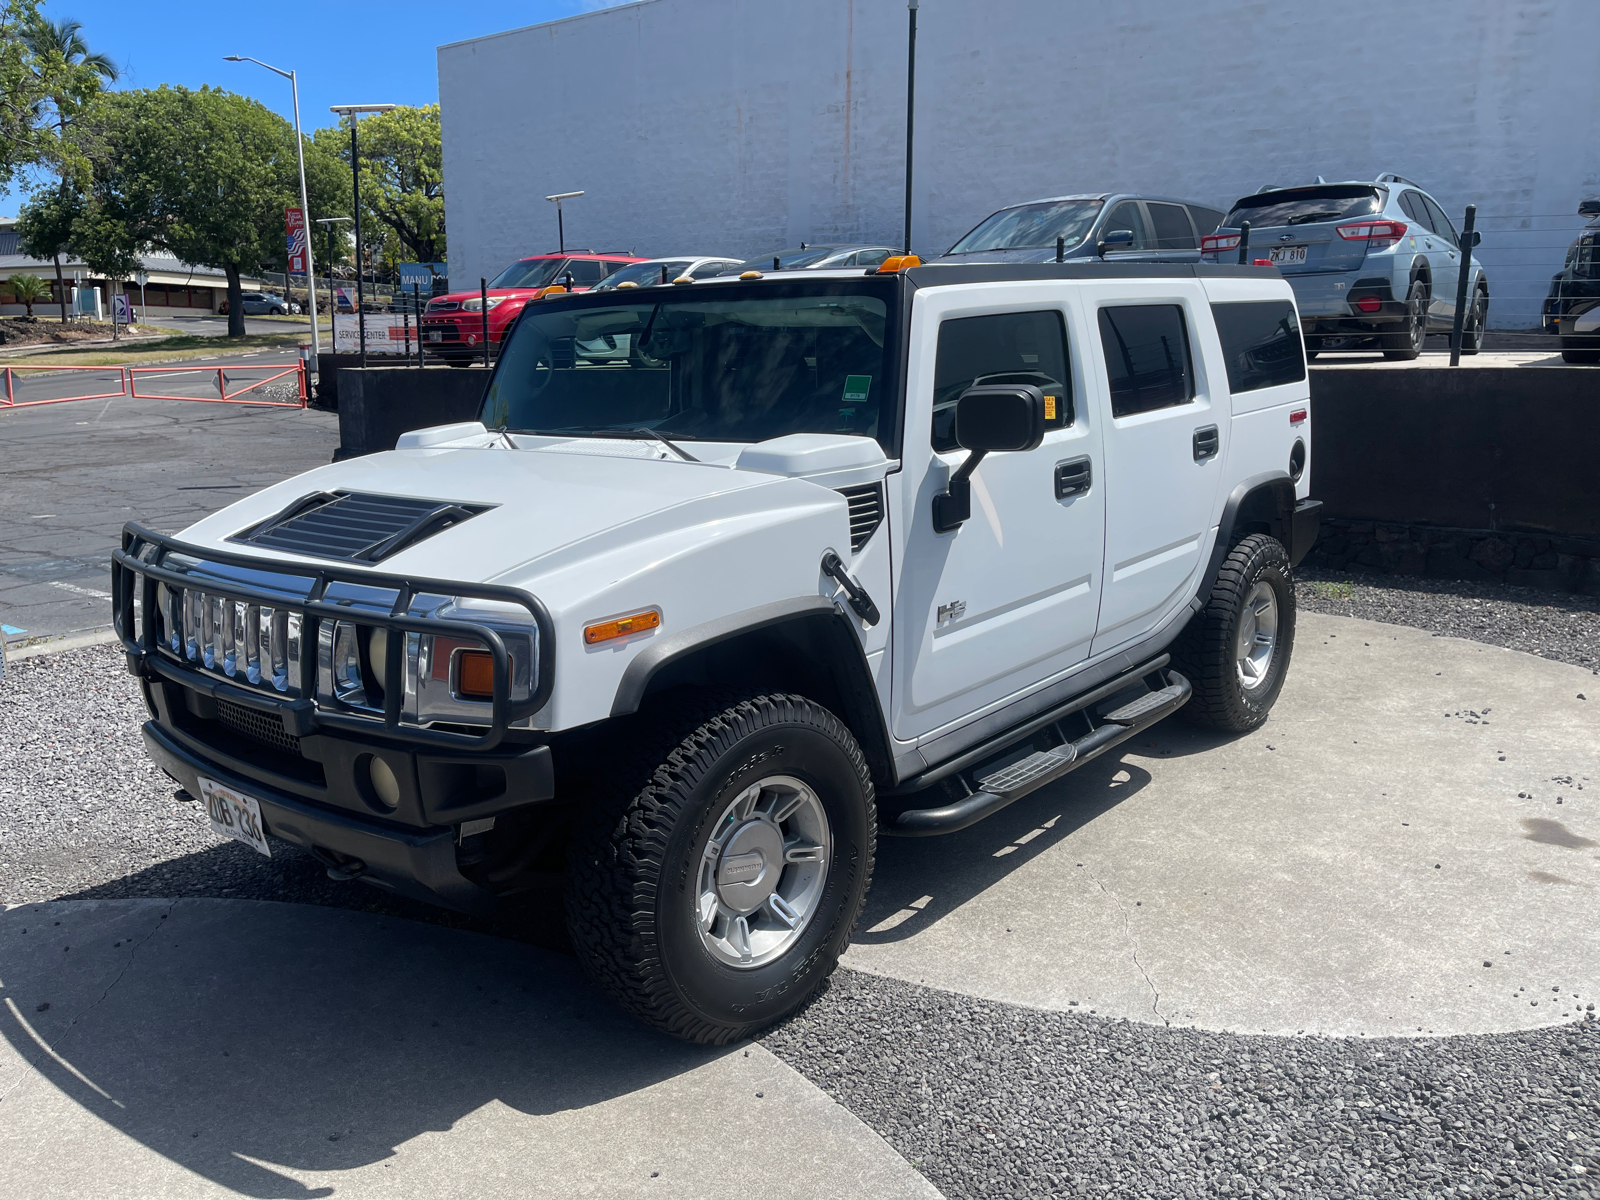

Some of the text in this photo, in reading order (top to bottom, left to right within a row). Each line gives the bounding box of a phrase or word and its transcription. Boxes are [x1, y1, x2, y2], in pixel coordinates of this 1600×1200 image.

[1270, 249, 1305, 261] ZKJ 810
[401, 275, 428, 285] MANU
[338, 330, 386, 340] SERVICE ENTER
[194, 615, 300, 656] UMMER
[727, 862, 763, 875] HUMMER
